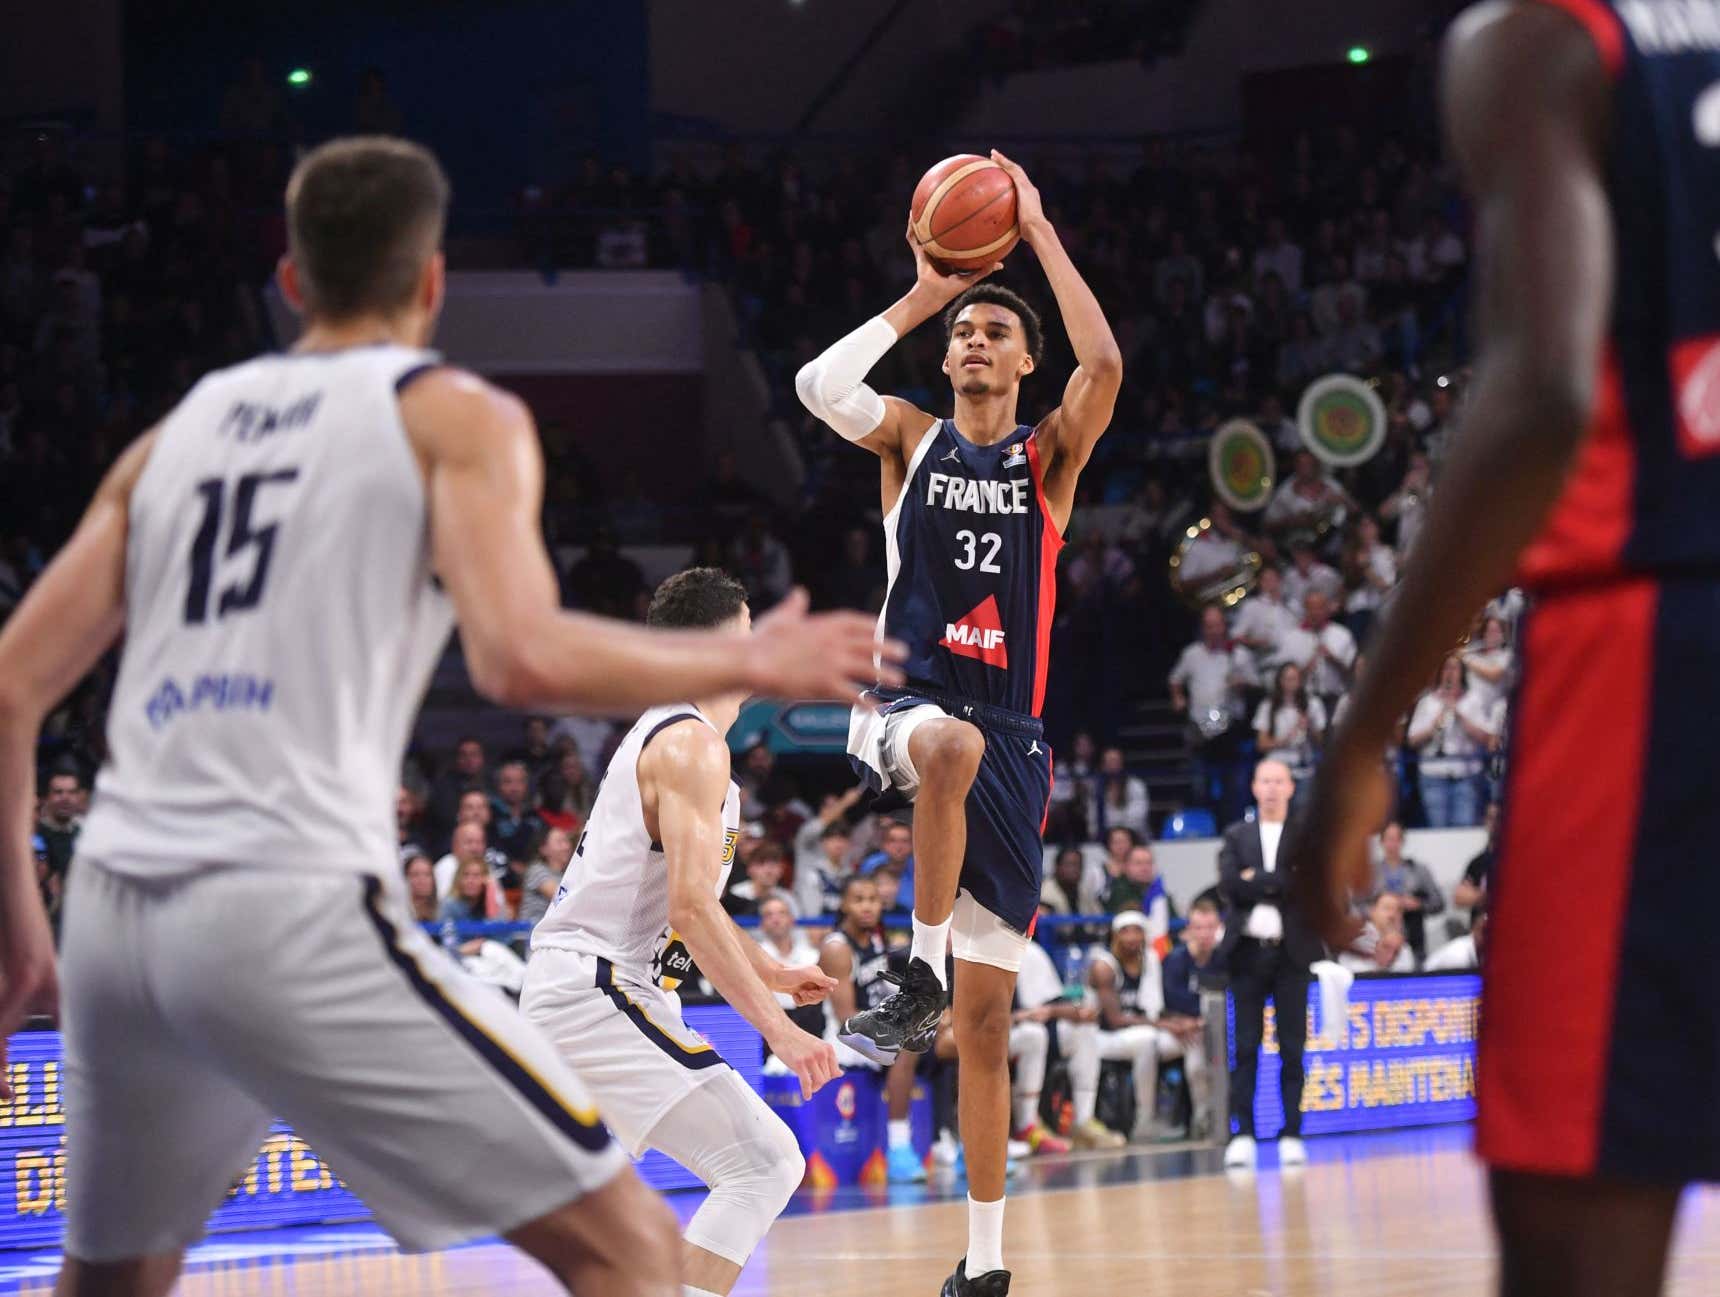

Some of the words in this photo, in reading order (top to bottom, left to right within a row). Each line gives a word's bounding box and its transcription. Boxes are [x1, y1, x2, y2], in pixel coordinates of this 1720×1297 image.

[926, 472, 1029, 514] FRANCE
[184, 466, 299, 626] 15
[954, 530, 1002, 574] 32
[946, 623, 1005, 649] MAIF
